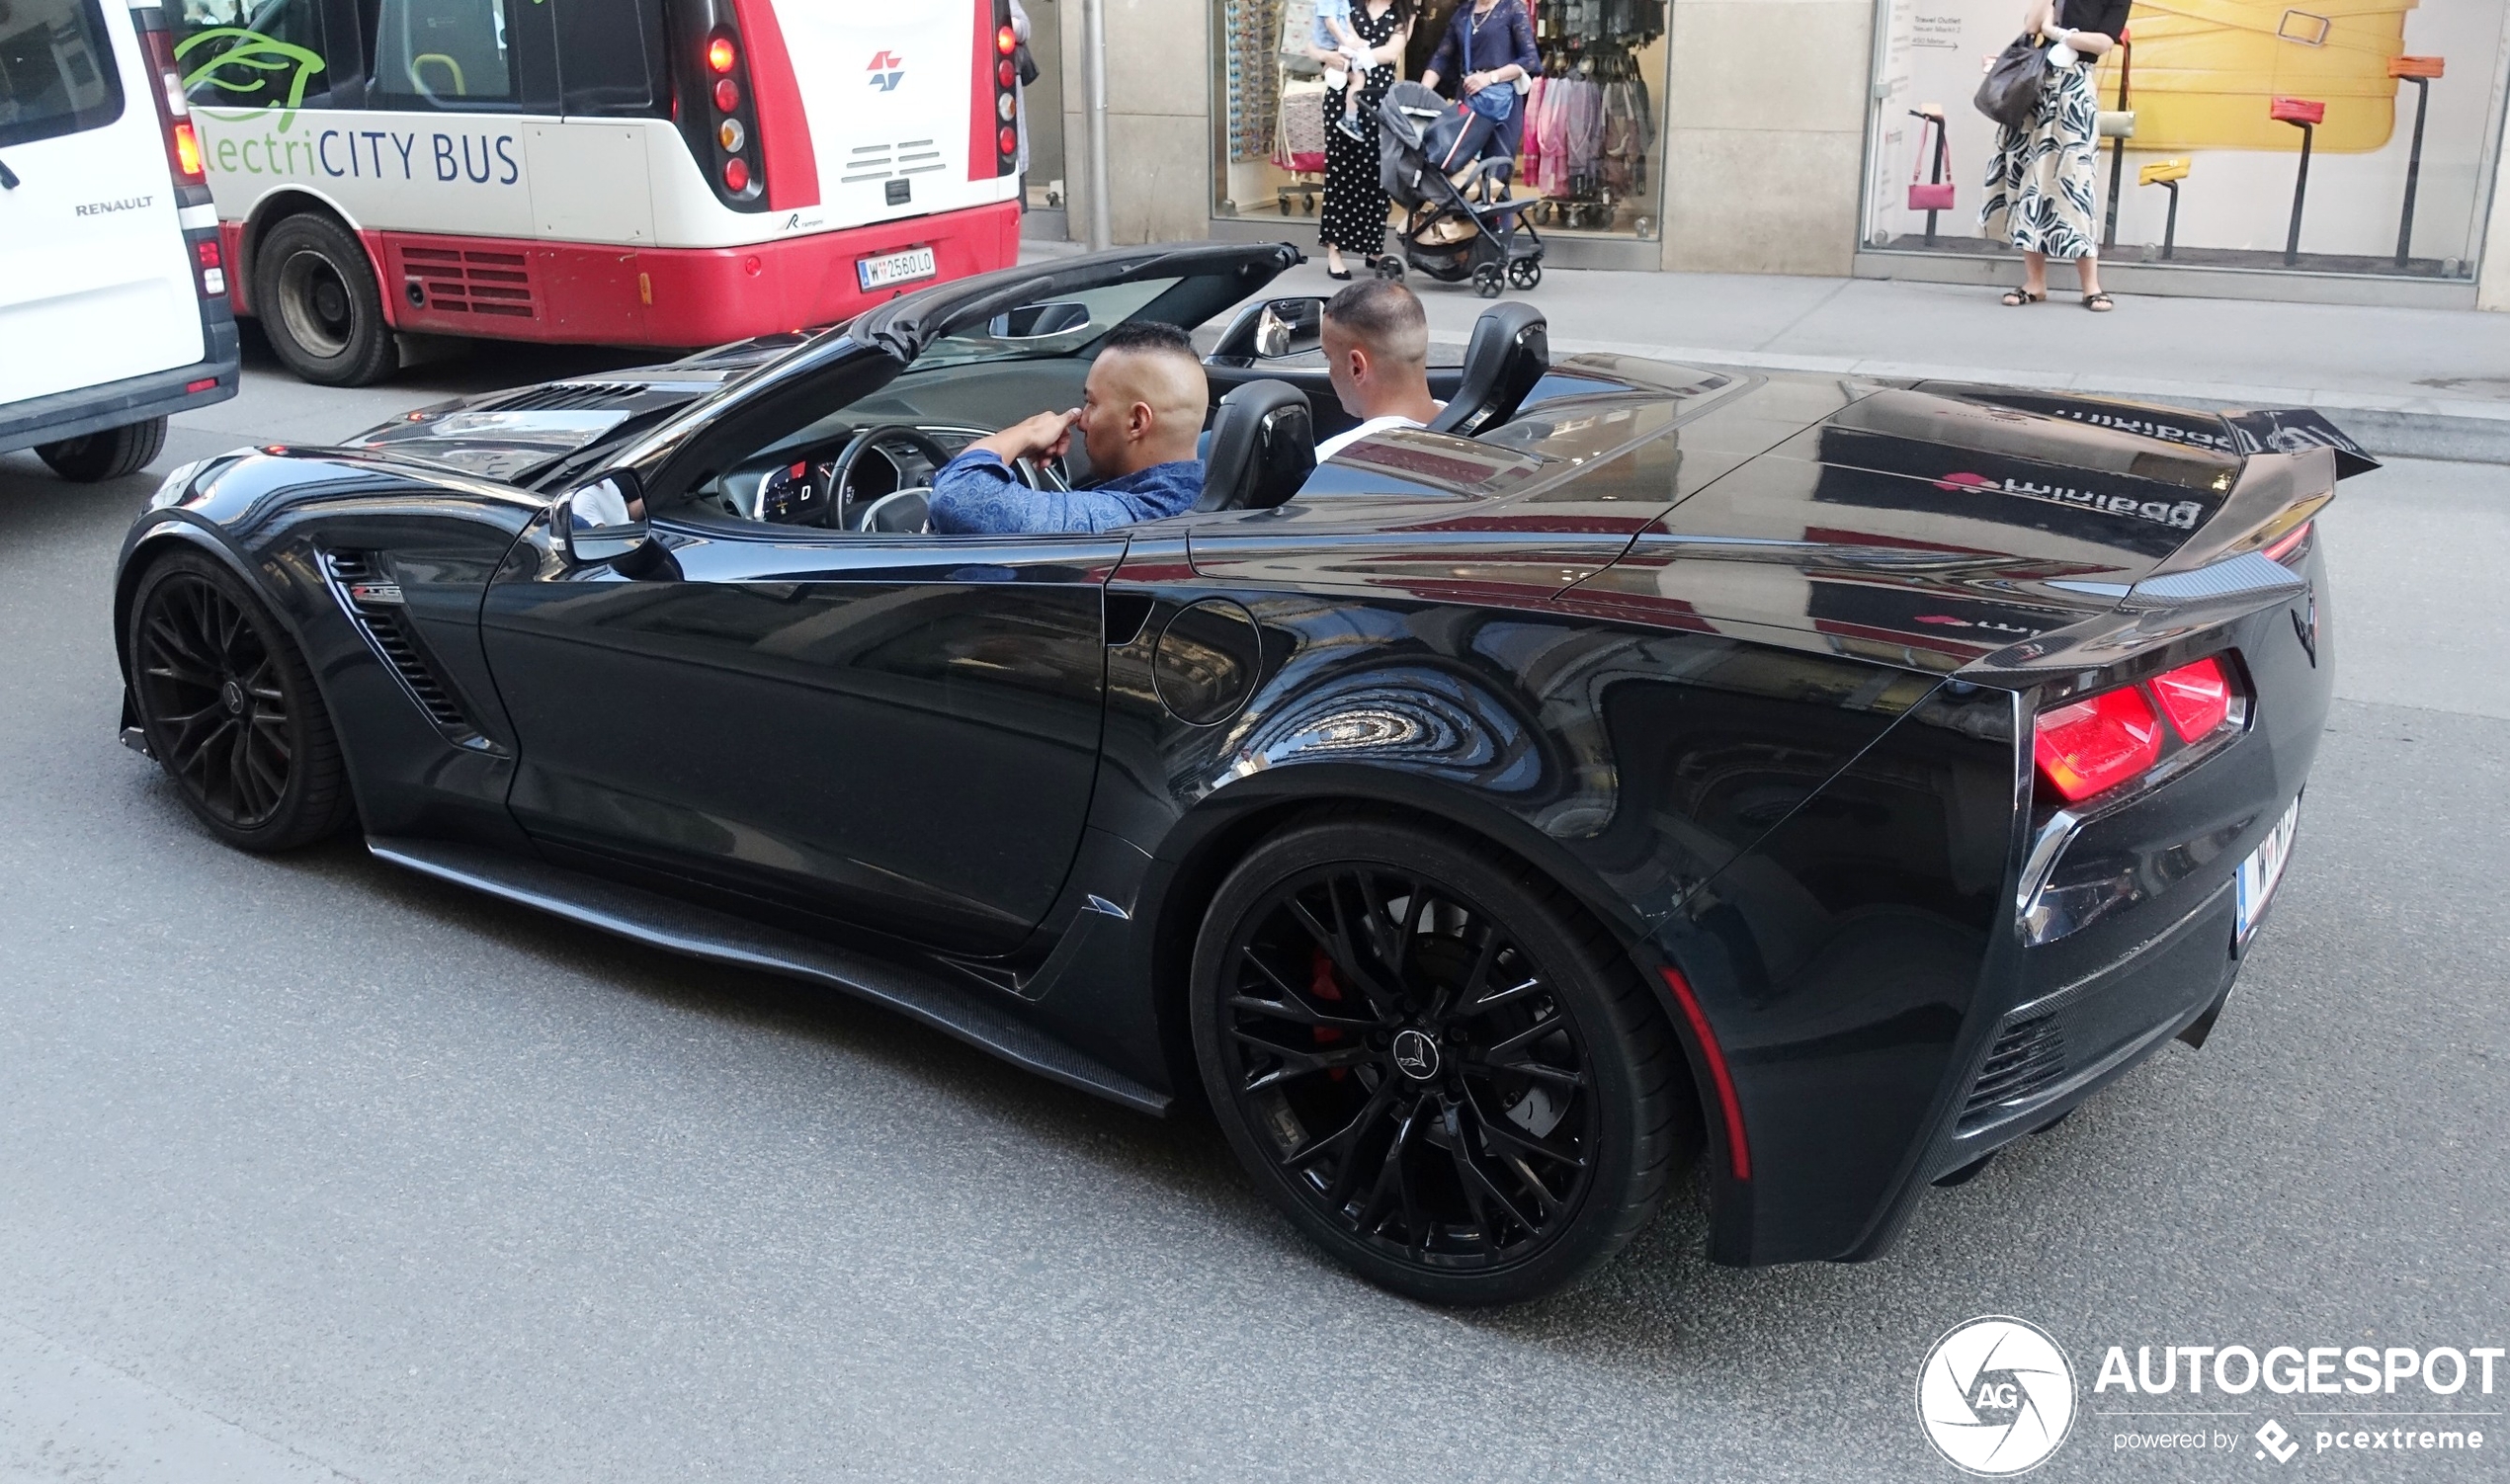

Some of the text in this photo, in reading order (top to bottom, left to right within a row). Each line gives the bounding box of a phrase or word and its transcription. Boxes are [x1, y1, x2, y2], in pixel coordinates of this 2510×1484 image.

[199, 126, 519, 186] lectriCITY BUS
[75, 196, 153, 216] RENAULT
[869, 263, 879, 282] W
[887, 256, 917, 278] 2560
